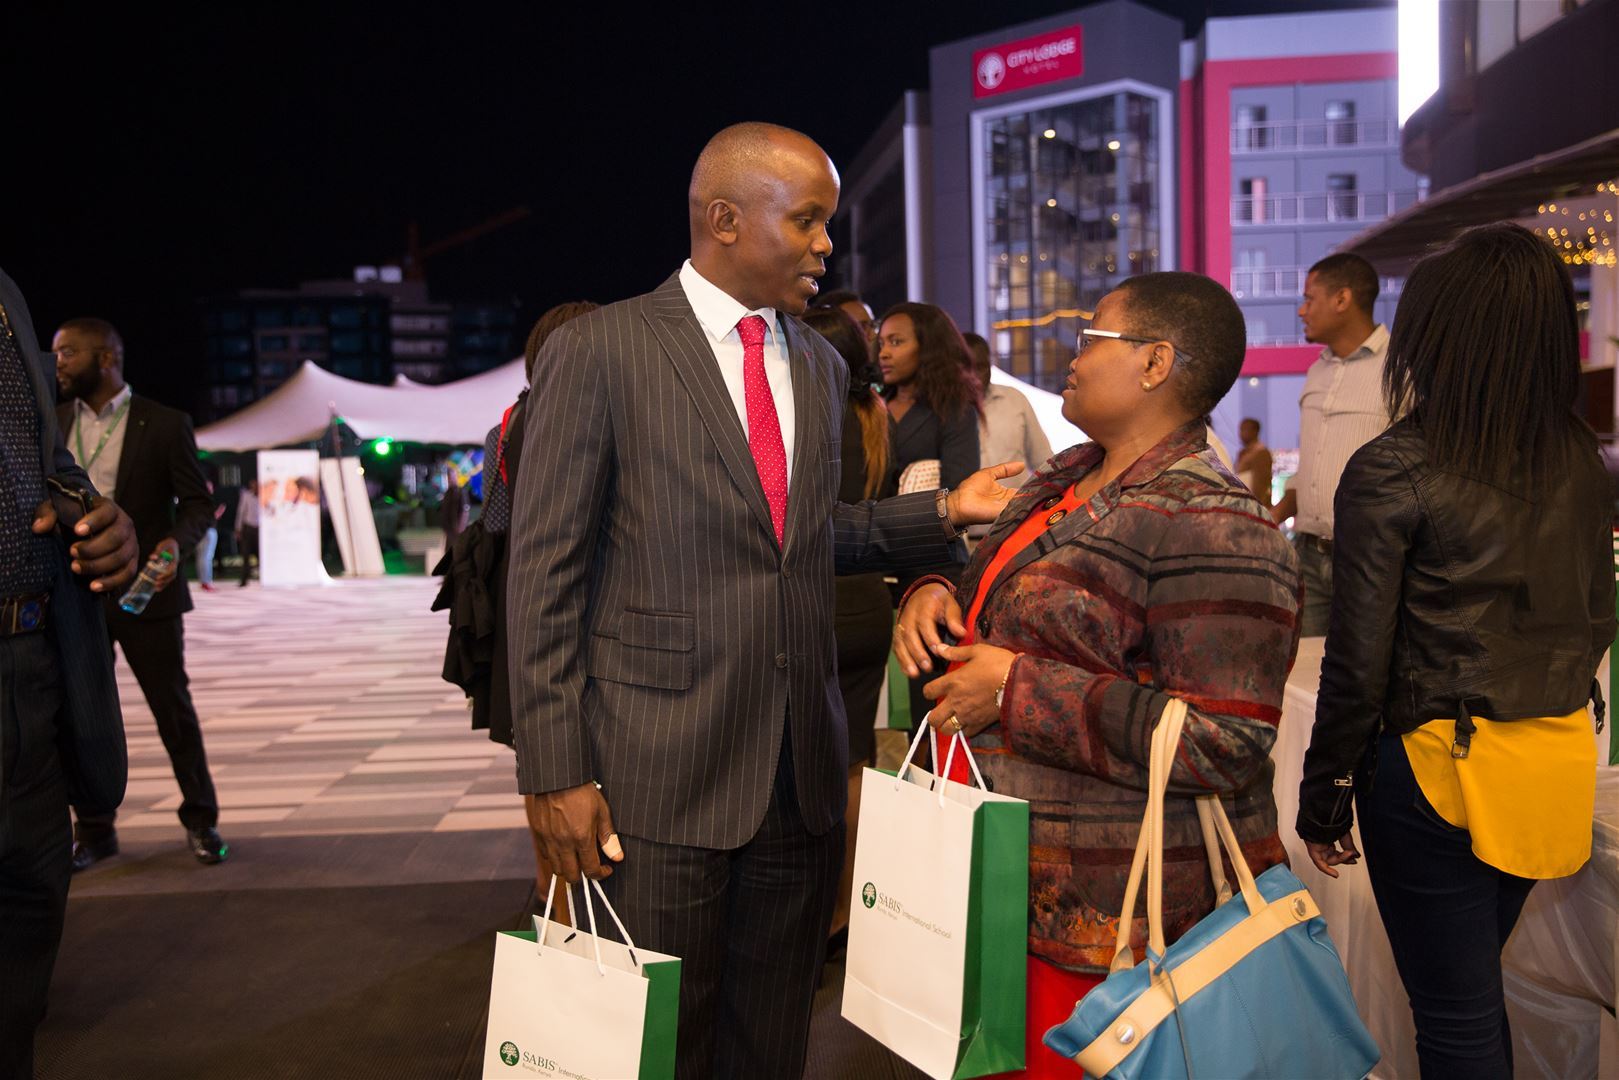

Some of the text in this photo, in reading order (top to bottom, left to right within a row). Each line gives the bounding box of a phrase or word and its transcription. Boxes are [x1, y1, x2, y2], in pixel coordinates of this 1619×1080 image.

[1007, 37, 1076, 68] CITY LODGE
[523, 1051, 555, 1071] SABIS
